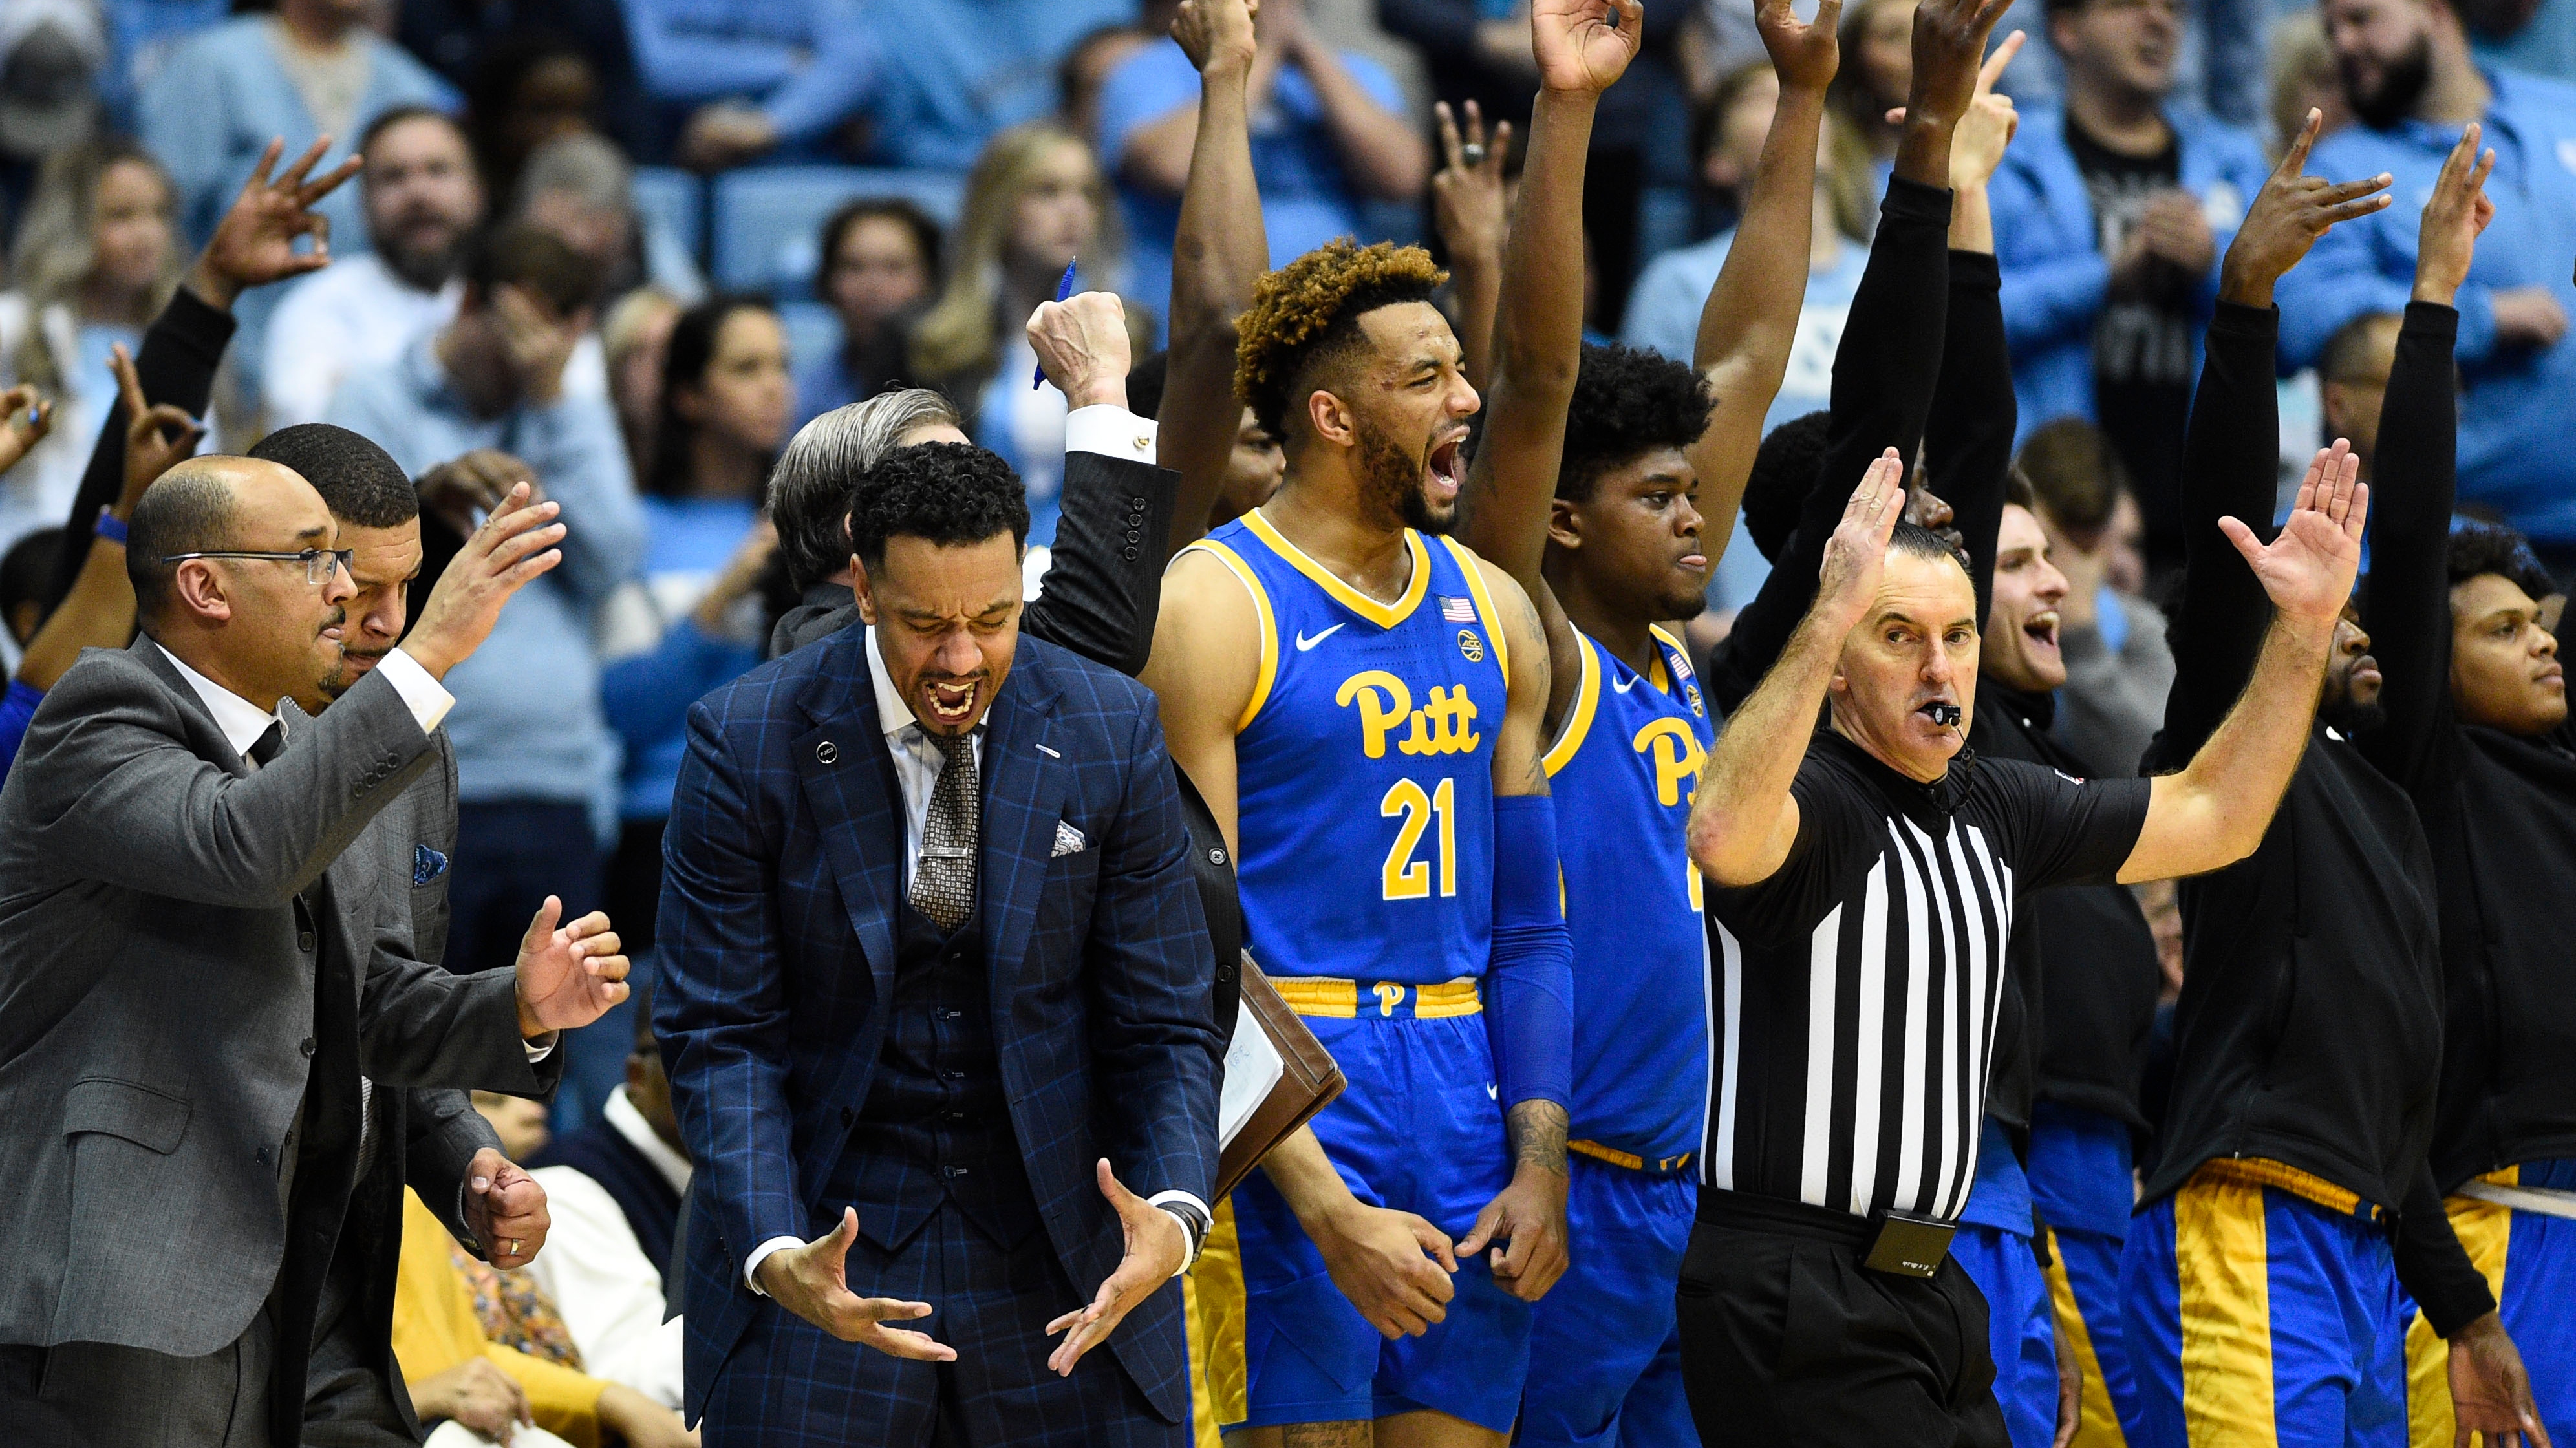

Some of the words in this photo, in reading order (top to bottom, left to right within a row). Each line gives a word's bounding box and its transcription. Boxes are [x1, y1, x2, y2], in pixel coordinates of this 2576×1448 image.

[1462, 639, 1480, 648] ACC
[1335, 670, 1480, 758] Pitt
[1380, 777, 1457, 901] 21
[1372, 980, 1405, 1016] P
